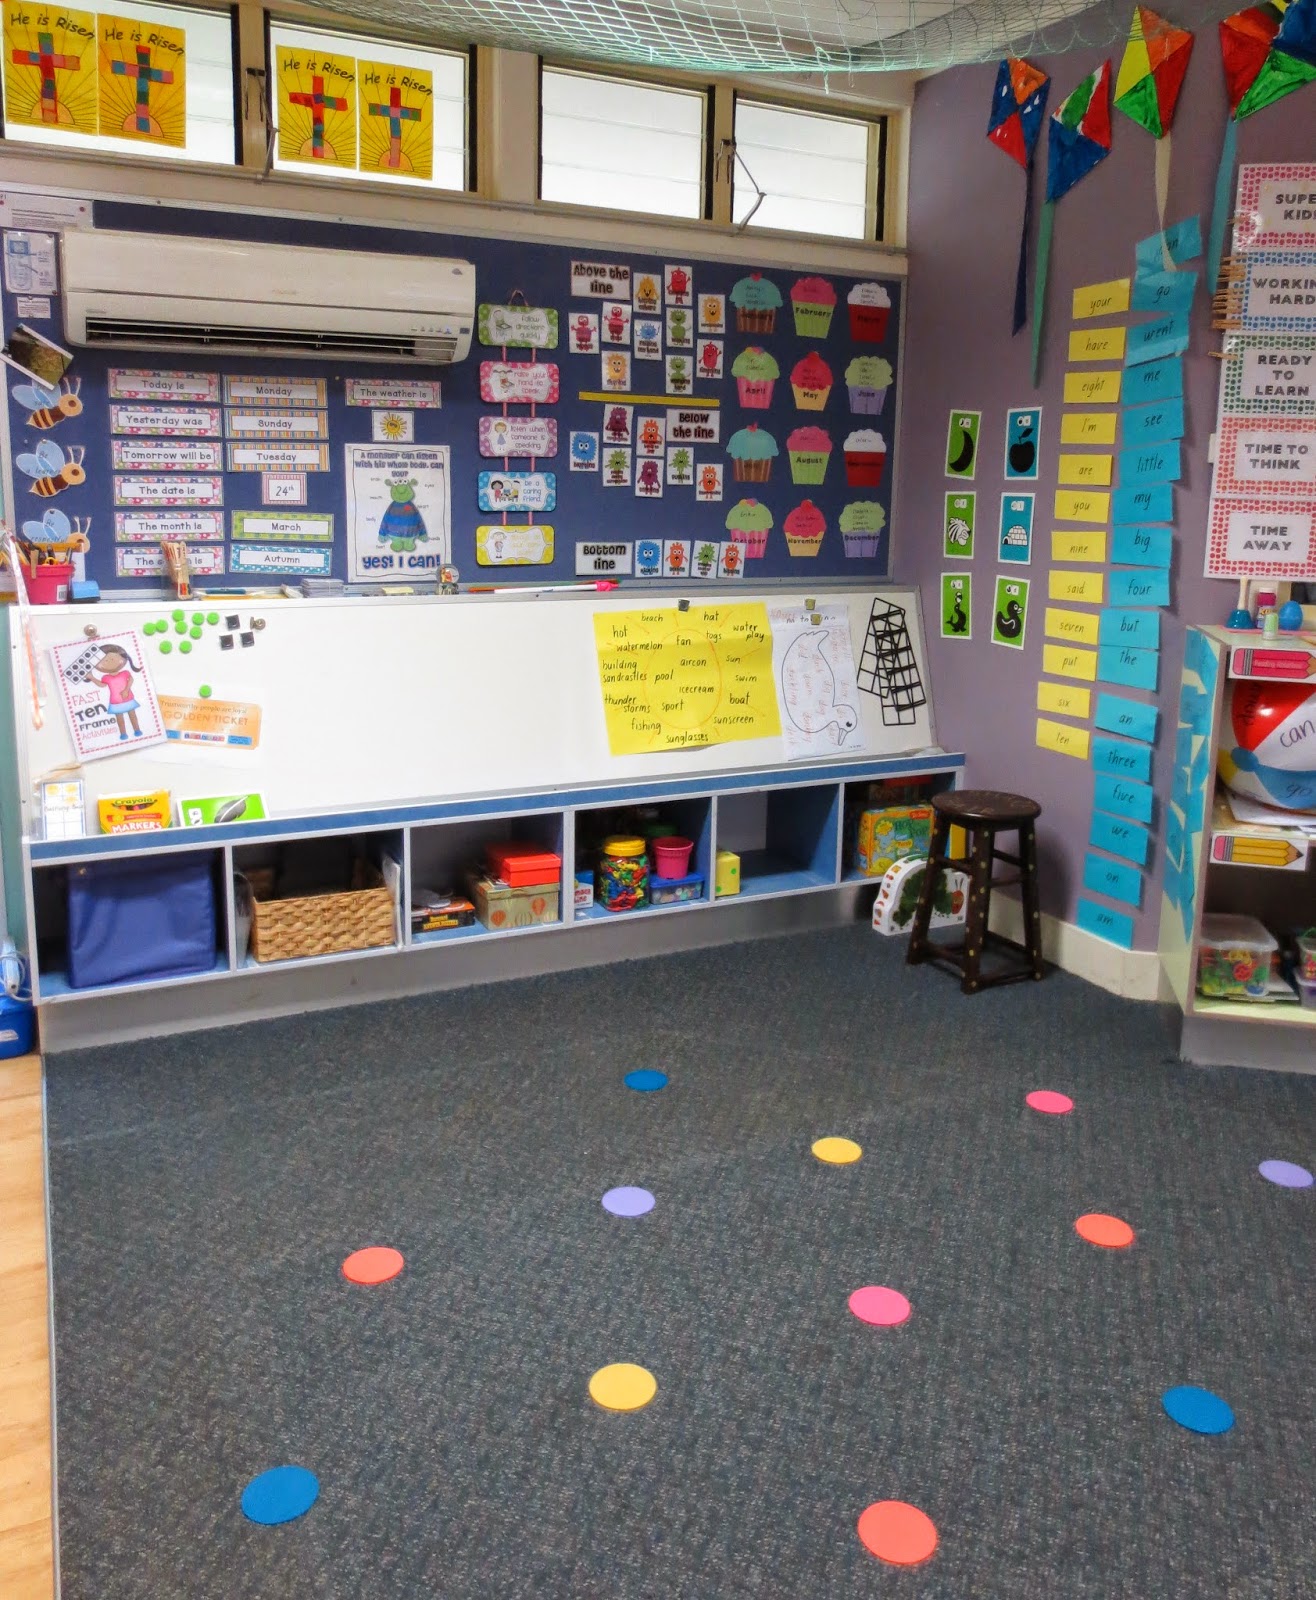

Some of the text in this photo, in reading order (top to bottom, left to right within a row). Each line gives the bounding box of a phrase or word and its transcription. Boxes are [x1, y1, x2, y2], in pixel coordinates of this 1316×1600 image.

[10, 14, 95, 40] He is Risen
[105, 29, 185, 55] He is Risen
[284, 59, 355, 82] He is Risen
[365, 72, 432, 96] He is Risen
[574, 264, 629, 280] Above the
[590, 281, 614, 294] line
[1155, 285, 1170, 304] go
[1269, 294, 1316, 305] HARD
[1090, 296, 1112, 316] your
[1085, 337, 1109, 351] have
[1257, 354, 1313, 366] READY
[1143, 369, 1161, 384] me
[1272, 370, 1295, 381] TO
[142, 380, 174, 391] Today
[256, 386, 292, 397] Monday
[1081, 378, 1105, 398] eight
[1255, 385, 1309, 396] LEARN
[360, 388, 378, 397] The
[380, 389, 416, 398] weather
[126, 415, 203, 426] Yesterday was
[258, 419, 293, 429] Sunday
[679, 412, 710, 424] Below
[1143, 413, 1163, 428] see
[673, 426, 715, 439] the line
[1244, 443, 1309, 455] TIME TO
[123, 451, 212, 460] Tomorrow will be
[256, 452, 297, 462] Tuesday
[796, 456, 823, 465] August
[1136, 453, 1164, 473] little
[1250, 458, 1301, 470] THINK
[1078, 466, 1093, 476] are
[139, 486, 158, 495] The
[161, 486, 185, 495] date
[275, 485, 295, 498] 24th
[1133, 491, 1152, 511] my
[1073, 501, 1090, 516] you
[138, 522, 158, 531] The
[160, 522, 191, 531] month
[271, 522, 302, 532] March
[1251, 525, 1288, 536] TIME
[1134, 528, 1151, 553] big
[1243, 540, 1292, 551] AWAY
[1069, 544, 1089, 554] nine
[135, 557, 154, 566] The
[264, 555, 301, 564] Autumn
[593, 558, 616, 570] line
[1066, 582, 1086, 595] said
[1127, 578, 1152, 596] four
[641, 613, 664, 622] beach
[703, 611, 720, 621] hat
[732, 621, 759, 632] water
[1059, 621, 1085, 634] seven
[1120, 616, 1140, 633] but
[612, 625, 628, 638] hot
[706, 630, 722, 644] togs
[745, 630, 765, 643] play
[616, 641, 663, 652] watermelon
[676, 635, 692, 646] fan
[680, 658, 707, 667] aircon
[726, 654, 741, 664] sun
[1061, 655, 1079, 671] put
[1119, 649, 1138, 666] the
[602, 659, 638, 674] building
[603, 672, 648, 683] sandcastles
[654, 669, 674, 685] pool
[735, 673, 758, 682] swim
[679, 684, 714, 694] icecream
[72, 690, 101, 706] FAST
[604, 693, 638, 705] thunder
[729, 691, 752, 705] boat
[1057, 697, 1071, 708] six
[200, 705, 221, 714] people
[623, 703, 651, 714] storms
[661, 698, 685, 712] sport
[75, 703, 108, 722] Ten
[163, 711, 249, 726] GOLDEN TICKET
[79, 717, 117, 732] Frame
[713, 715, 754, 724] sunscreen
[1118, 714, 1134, 725] an
[631, 719, 662, 735] fishing
[666, 731, 709, 745] sunglasses
[1280, 719, 1316, 748] can
[1108, 750, 1136, 769] three
[1113, 783, 1136, 804] five
[114, 797, 153, 805] Crayola
[111, 820, 163, 834] MARKERS
[1110, 824, 1130, 839] we
